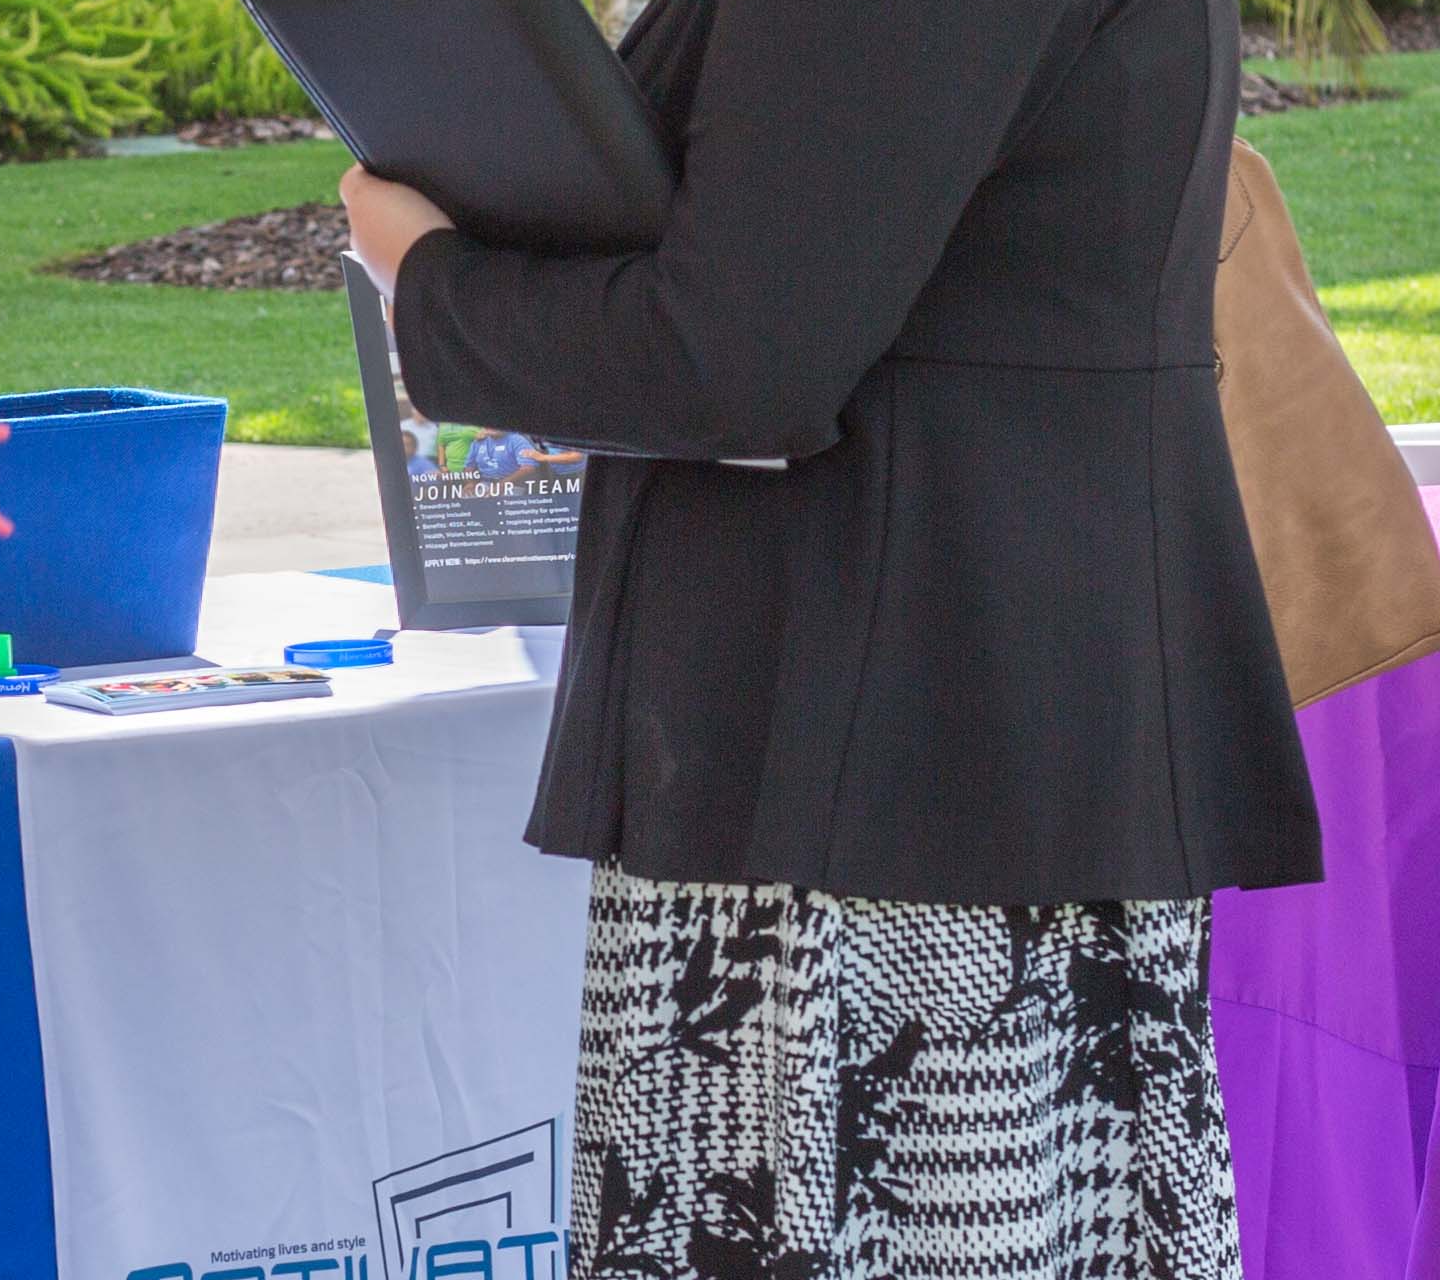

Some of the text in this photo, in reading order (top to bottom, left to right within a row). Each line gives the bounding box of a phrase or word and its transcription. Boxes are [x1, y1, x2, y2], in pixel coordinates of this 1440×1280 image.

[412, 471, 481, 483] NOW HIRING
[414, 478, 580, 502] JOIN OUR TEAM
[210, 1235, 367, 1264] Motivating lives and style
